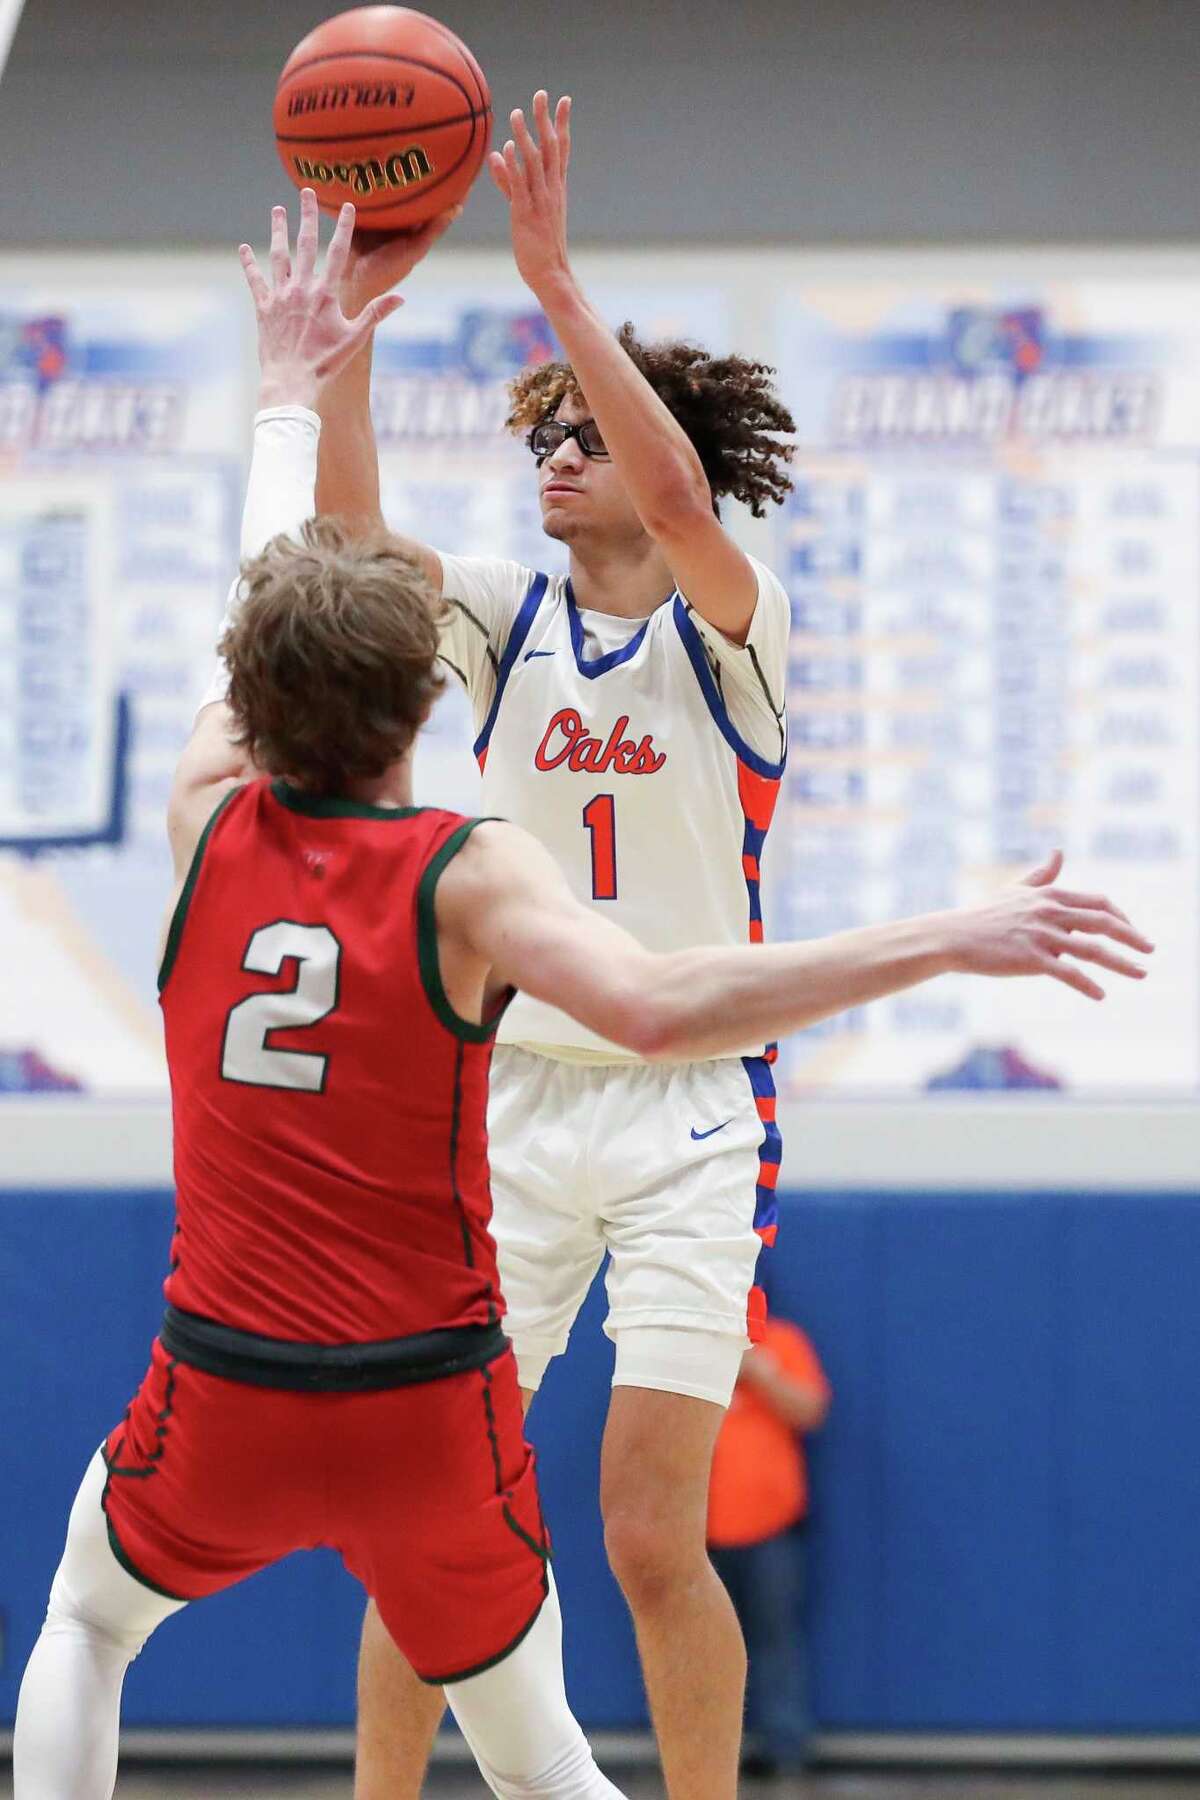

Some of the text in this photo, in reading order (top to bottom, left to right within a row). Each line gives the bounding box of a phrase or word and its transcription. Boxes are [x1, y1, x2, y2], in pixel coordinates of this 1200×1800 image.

[294, 146, 432, 194] Wilson
[535, 707, 667, 775] Oaks
[582, 793, 618, 900] 1
[220, 918, 341, 1093] 2
